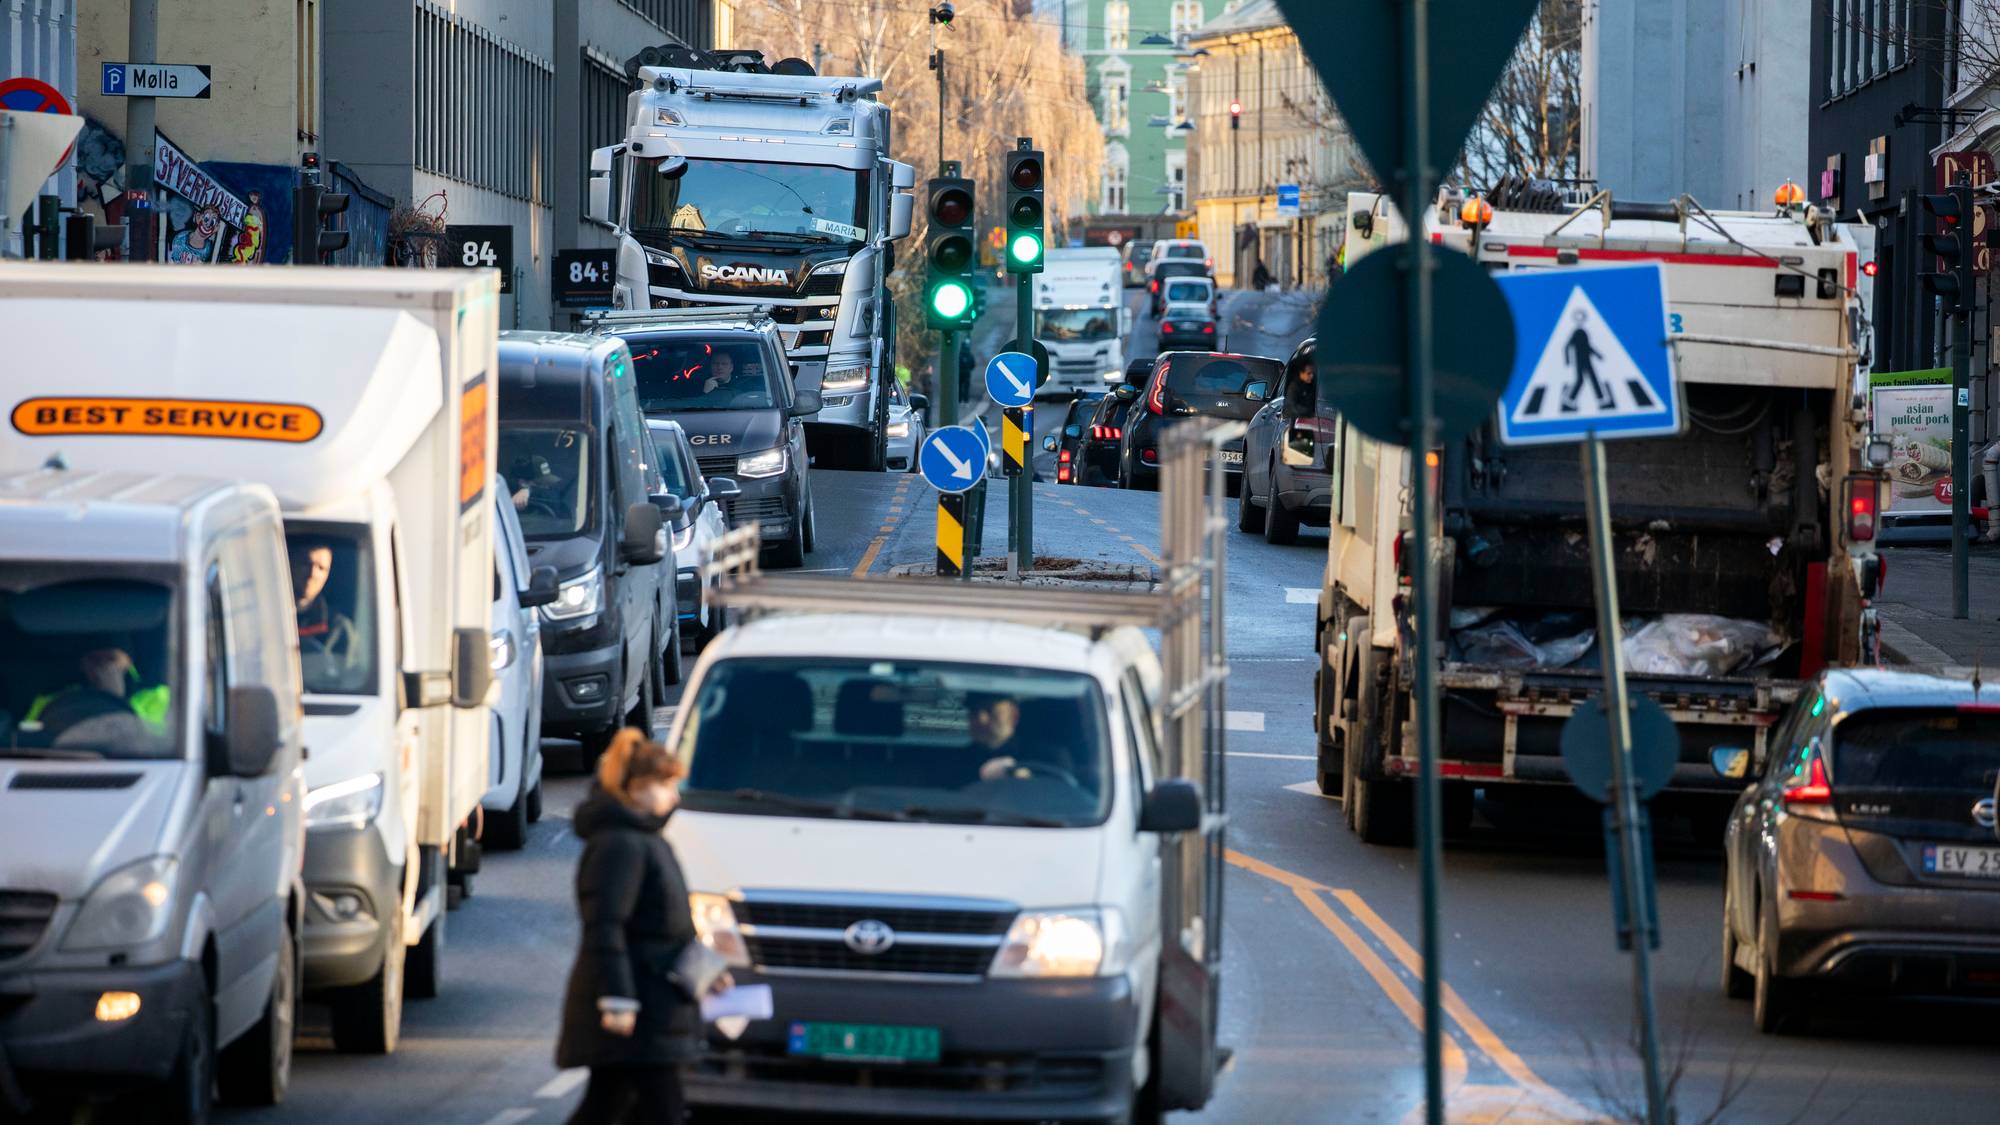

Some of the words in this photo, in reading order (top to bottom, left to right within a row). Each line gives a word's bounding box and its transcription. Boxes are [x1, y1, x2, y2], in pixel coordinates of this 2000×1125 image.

[133, 69, 178, 89] Mølla
[1944, 155, 1986, 189] Dli
[825, 222, 857, 237] MARIA
[462, 241, 497, 266] 84
[569, 261, 599, 283] 84
[701, 264, 788, 285] SCANIA
[1907, 403, 1933, 413] asian
[35, 407, 131, 425] BEST
[144, 408, 300, 431] SERVICE
[1891, 414, 1921, 426] pulled
[1926, 414, 1949, 426] pork
[690, 434, 732, 445] GER
[1851, 803, 1891, 813] LEAF
[1943, 851, 1967, 868] EV
